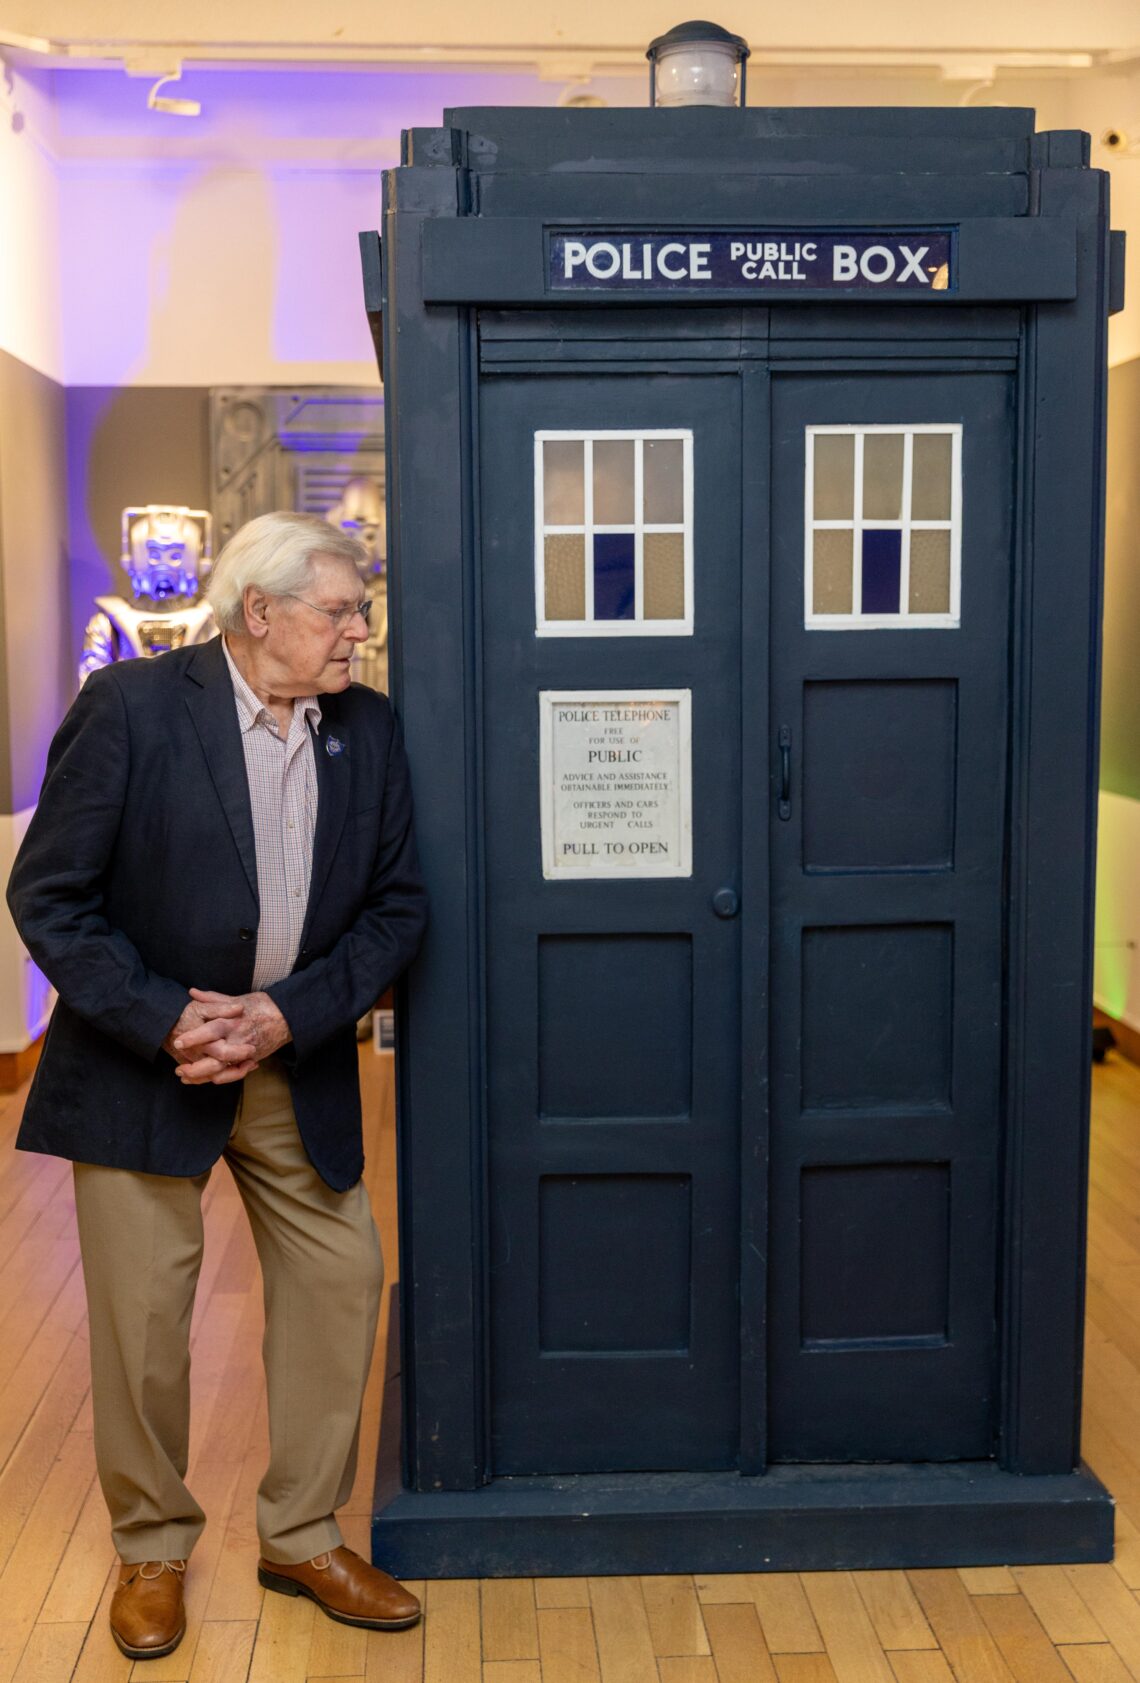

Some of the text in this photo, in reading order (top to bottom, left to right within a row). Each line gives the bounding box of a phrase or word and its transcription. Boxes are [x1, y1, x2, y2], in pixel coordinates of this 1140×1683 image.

[564, 242, 712, 280] POLICE
[730, 242, 818, 261] PUBLIC
[742, 261, 806, 280] CALL
[833, 246, 930, 282] BOX
[559, 710, 671, 722] POLICE TELEPHONE
[588, 750, 642, 763] PUBLIC
[563, 842, 668, 855] PULL TO OPEN
